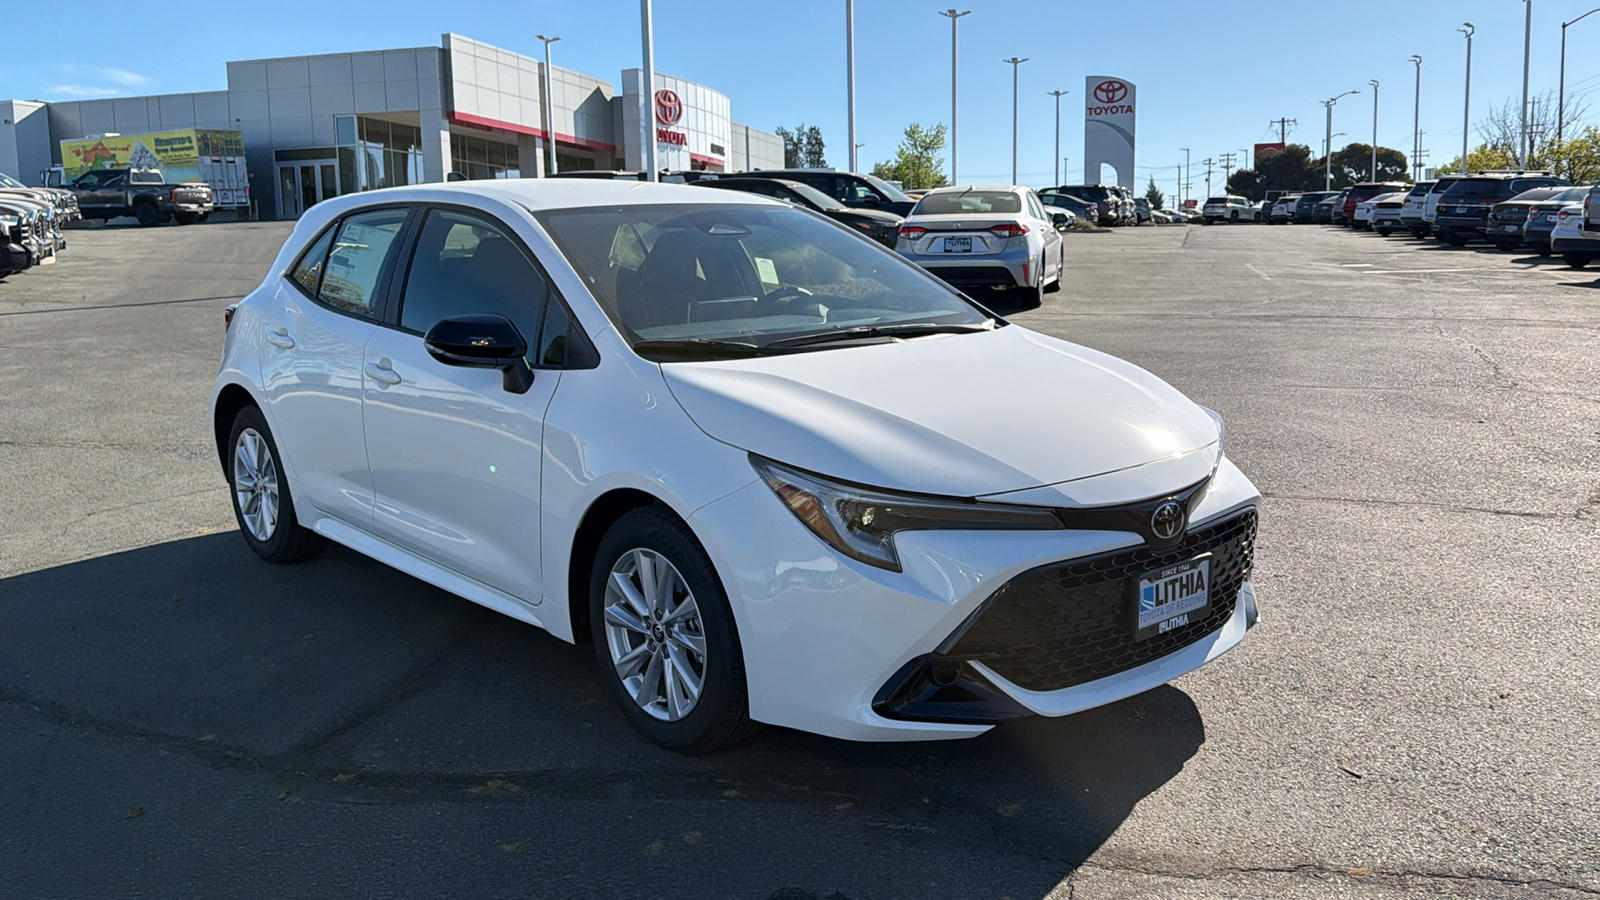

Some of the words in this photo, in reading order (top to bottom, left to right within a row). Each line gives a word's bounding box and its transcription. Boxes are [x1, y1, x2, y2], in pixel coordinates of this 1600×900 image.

[1087, 104, 1134, 116] TOYOTA
[656, 127, 687, 146] OYOTA
[1161, 566, 1177, 578] SINCE
[1155, 570, 1205, 607] LITHIA
[1139, 607, 1165, 623] TOYOTA
[1166, 603, 1175, 614] OF
[1176, 593, 1206, 610] REDDING
[1166, 613, 1189, 631] LITHIA
